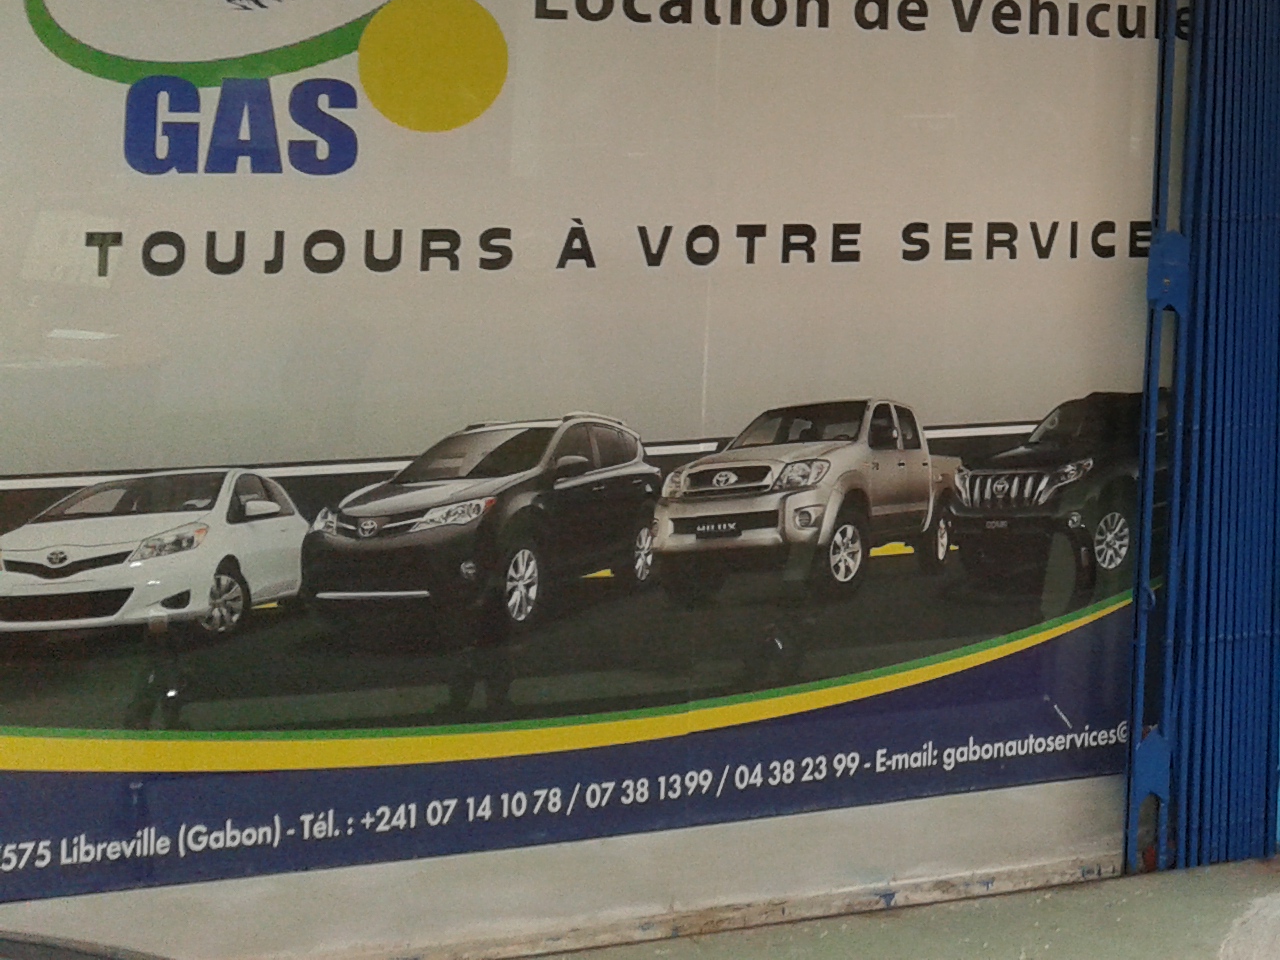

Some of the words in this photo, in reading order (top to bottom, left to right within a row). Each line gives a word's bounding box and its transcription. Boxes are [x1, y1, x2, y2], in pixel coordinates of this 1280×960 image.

[123, 74, 358, 176] GAS
[85, 226, 514, 276] TOUJOURS
[555, 218, 596, 270] À
[636, 222, 862, 267] VOTRE
[901, 220, 1152, 262] SERVICE
[0, 840, 51, 872] 575
[60, 827, 171, 865] Libreville
[178, 814, 281, 857] (Gabon)
[361, 803, 417, 833] +241
[427, 798, 459, 827] 07
[466, 794, 491, 822] 14
[500, 791, 527, 819] 10
[533, 787, 561, 815] 78
[586, 782, 616, 809] 07
[621, 778, 649, 805] 38
[734, 762, 764, 790] 04
[768, 759, 795, 785] 38
[801, 756, 827, 782] 23
[833, 751, 860, 778] 99
[876, 741, 938, 773] E-mail:
